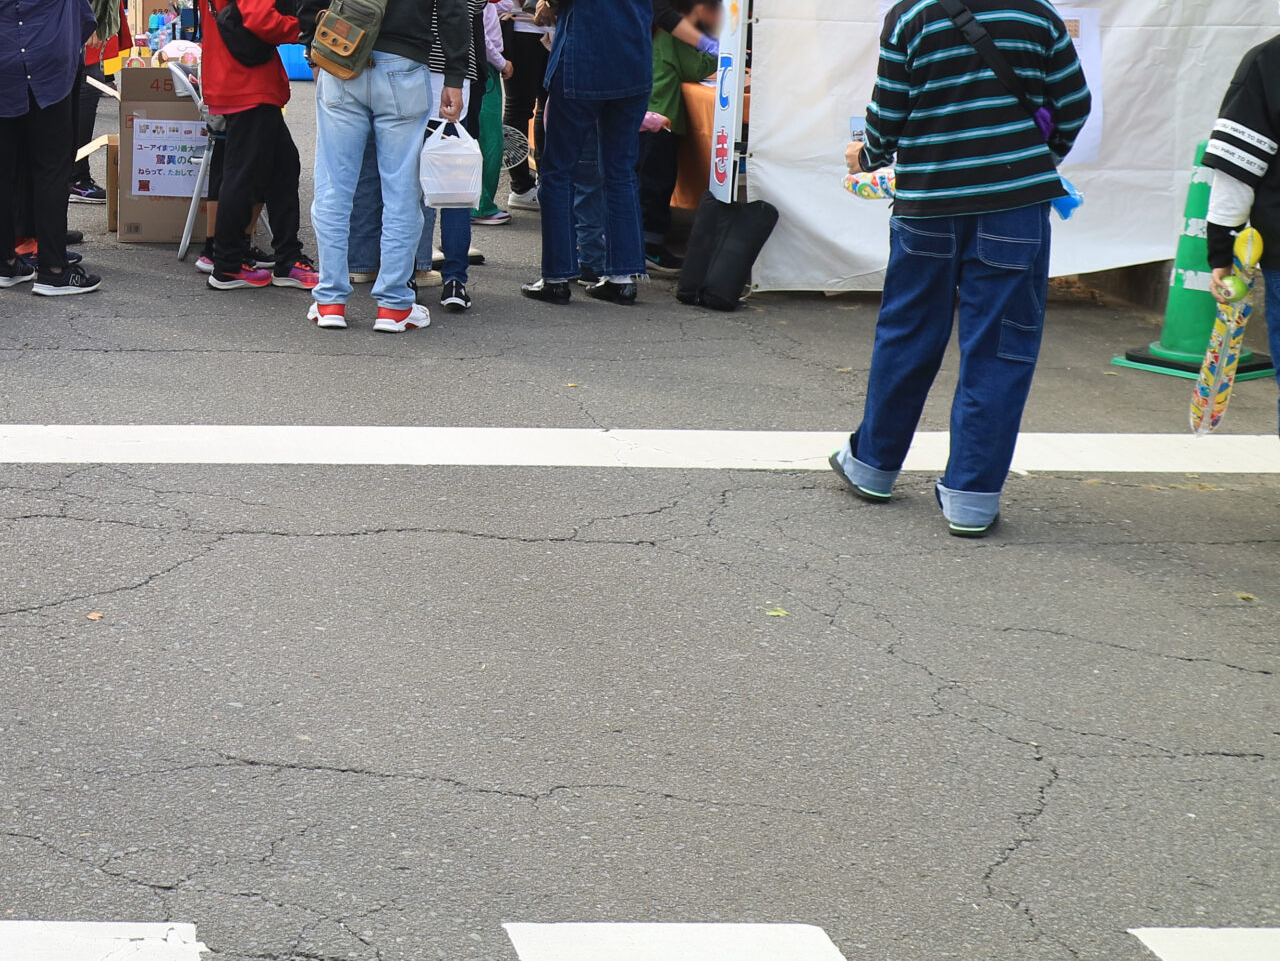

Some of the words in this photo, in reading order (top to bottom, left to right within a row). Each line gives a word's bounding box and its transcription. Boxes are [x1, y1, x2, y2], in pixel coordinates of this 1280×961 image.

[137, 144, 197, 152] ユーアイまつり最大
